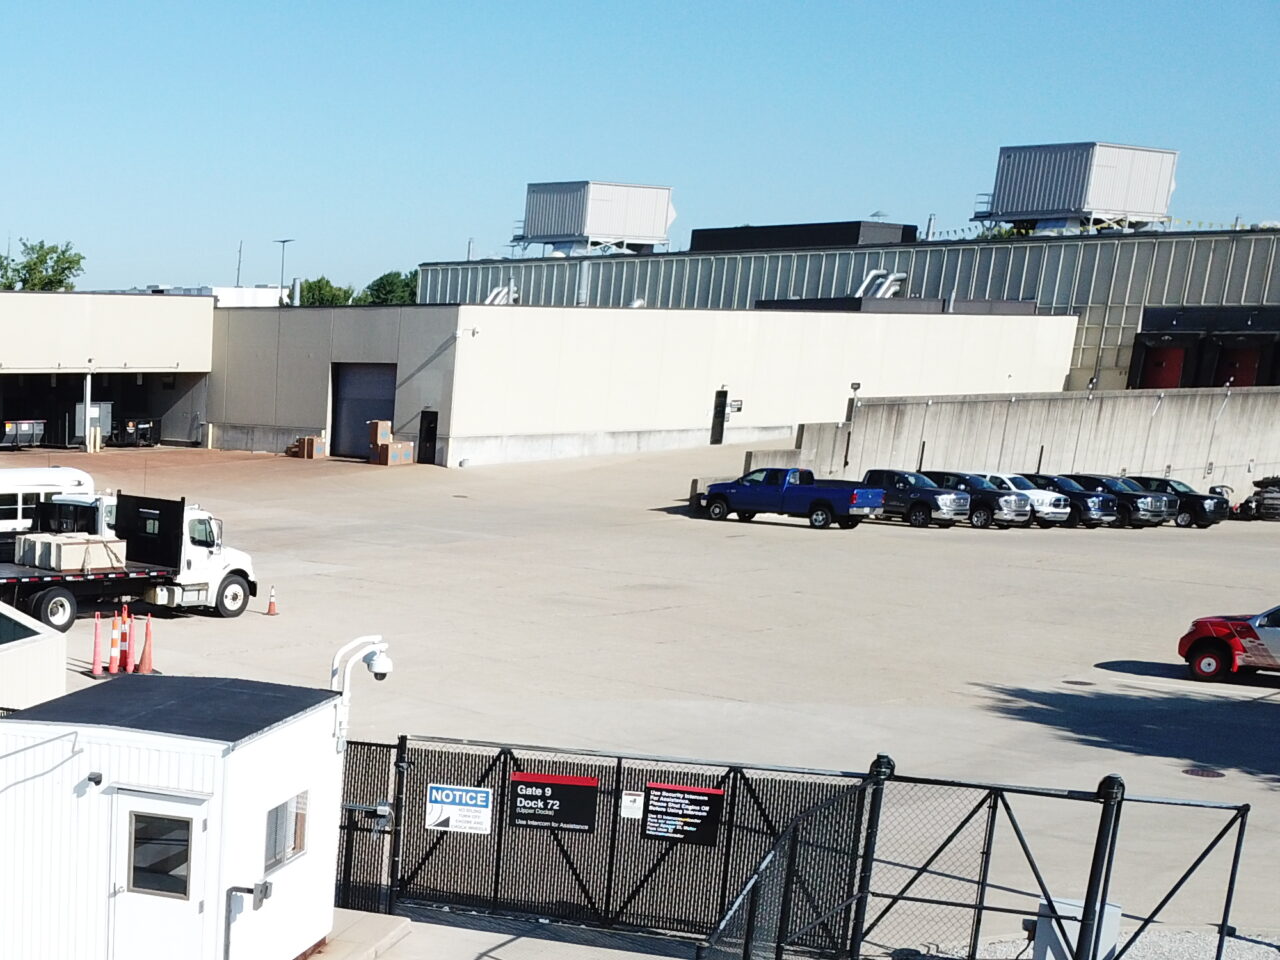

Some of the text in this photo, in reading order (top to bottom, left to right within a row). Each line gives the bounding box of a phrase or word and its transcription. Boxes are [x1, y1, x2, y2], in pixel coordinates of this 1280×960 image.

[517, 785, 552, 796] Gate 9
[431, 789, 487, 805] NOTICE
[516, 797, 560, 809] Dock 72
[559, 822, 588, 830] Assistance
